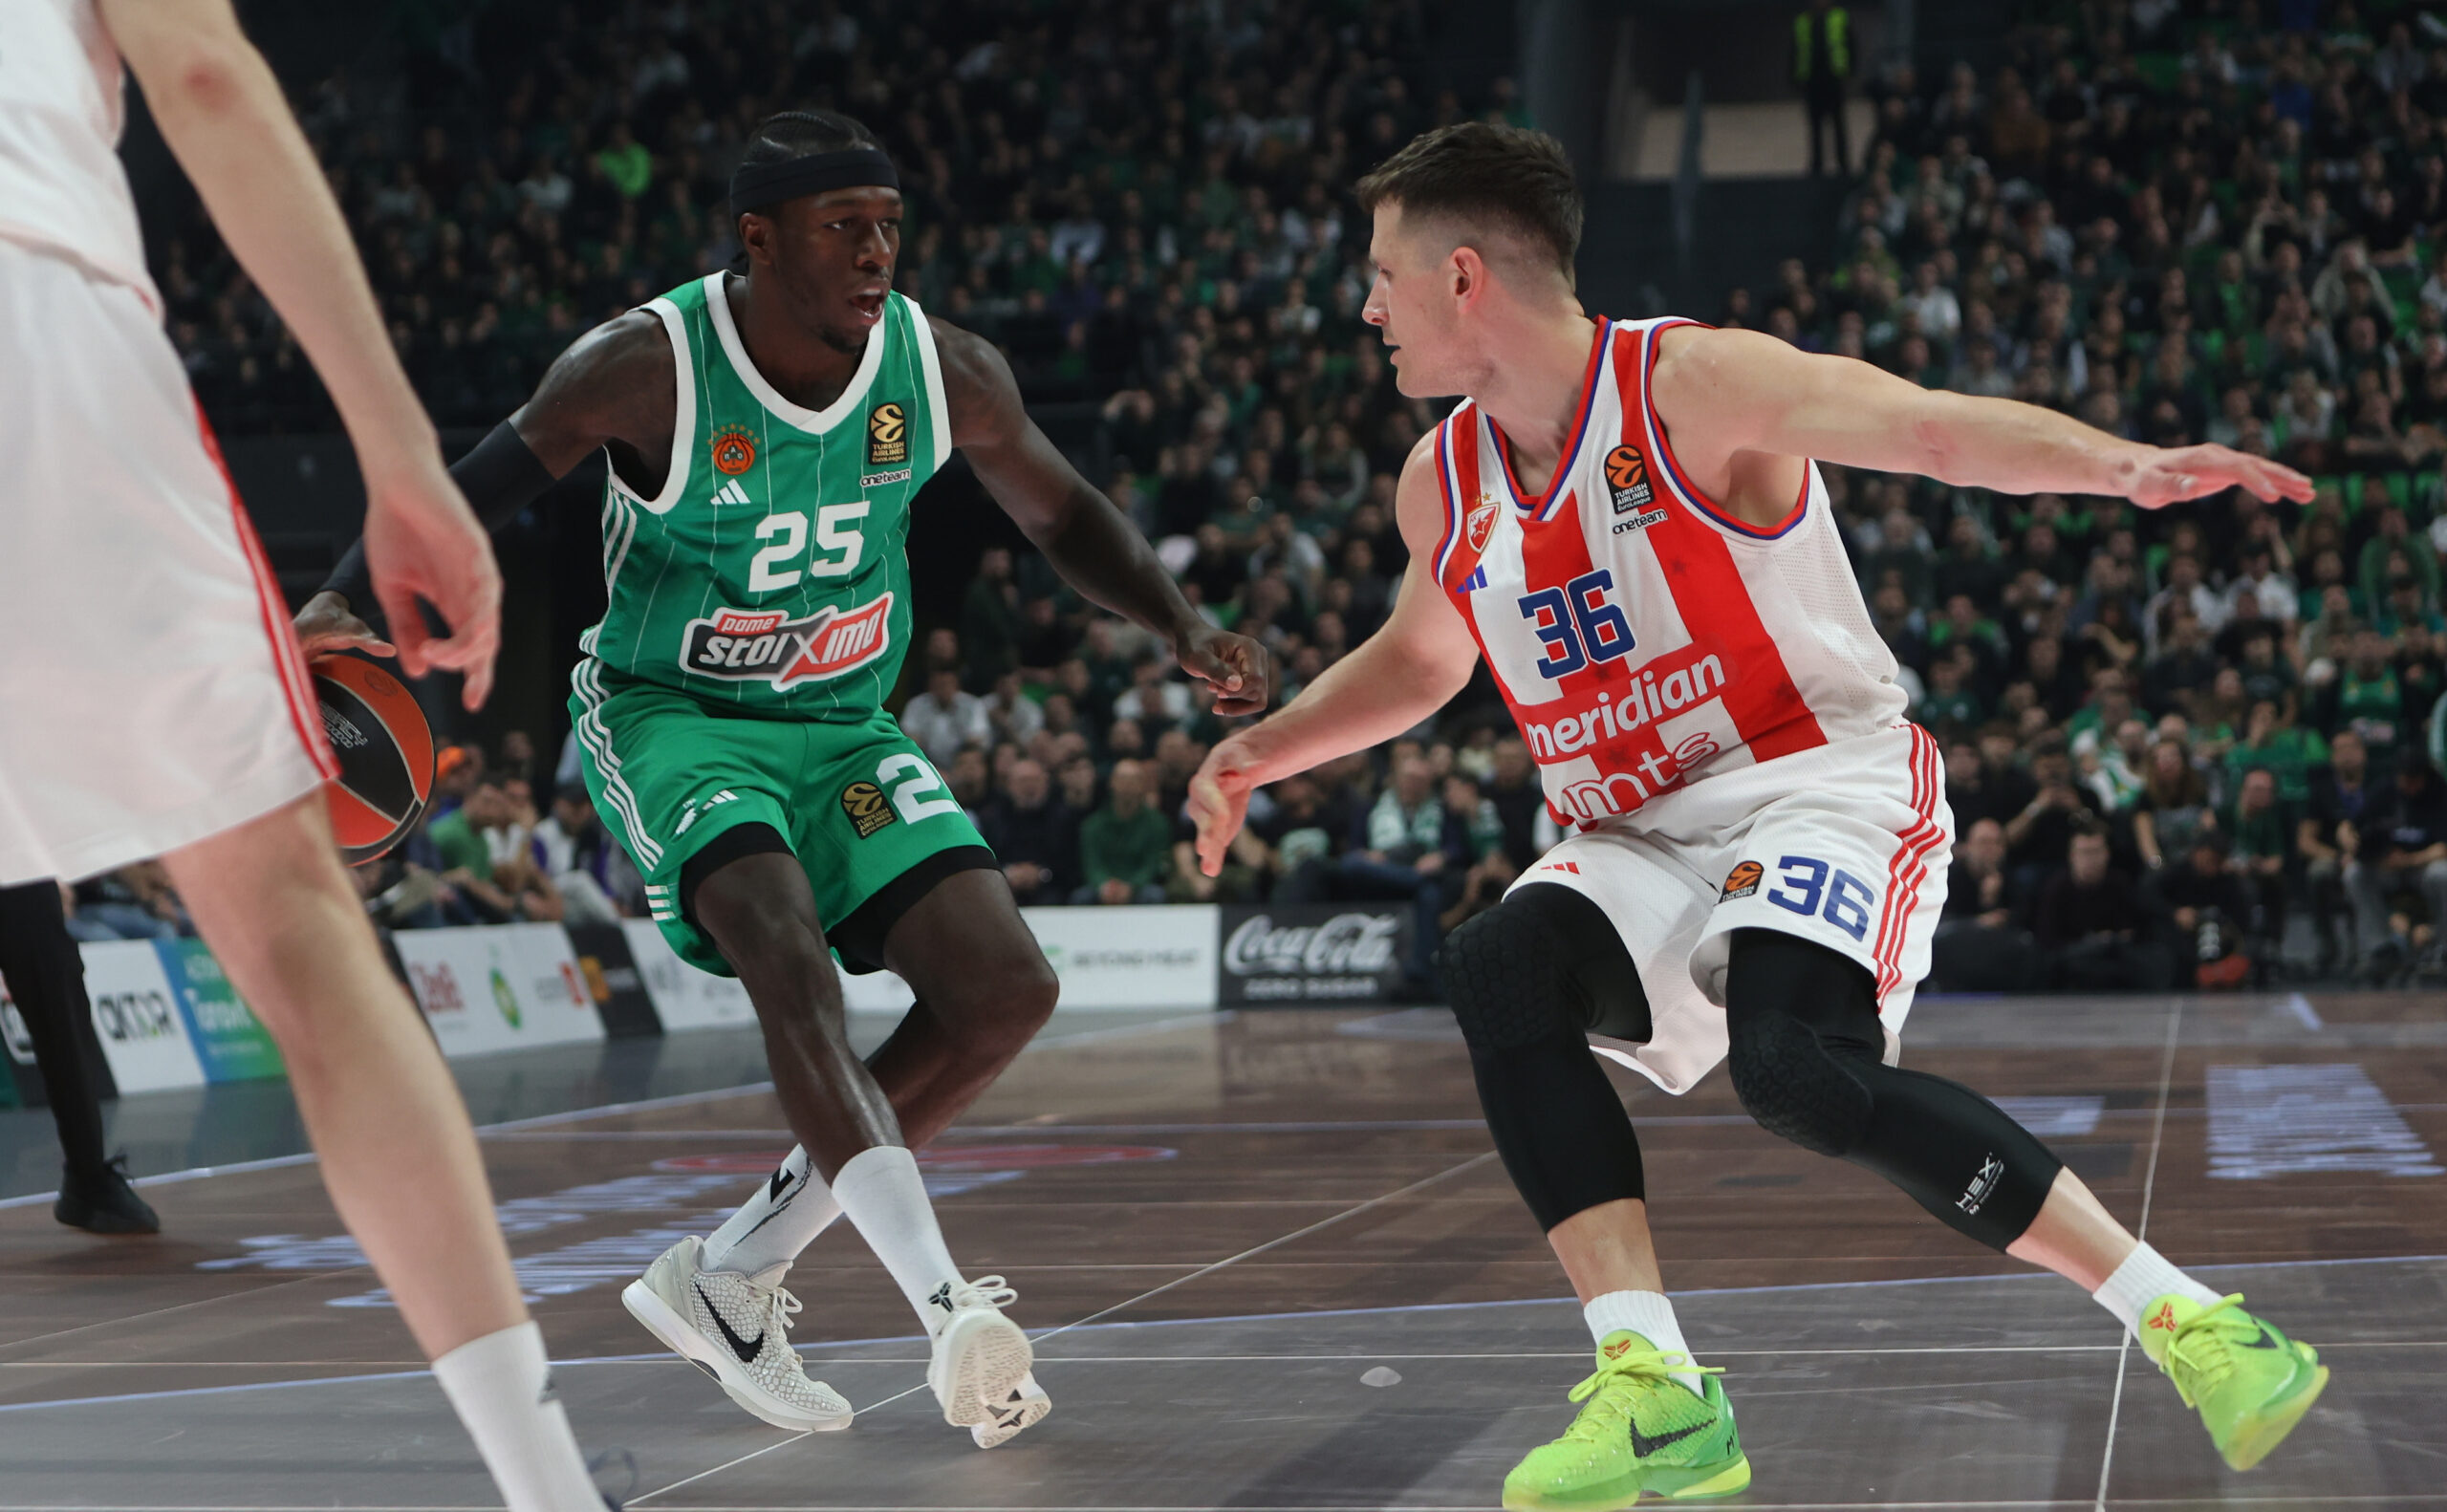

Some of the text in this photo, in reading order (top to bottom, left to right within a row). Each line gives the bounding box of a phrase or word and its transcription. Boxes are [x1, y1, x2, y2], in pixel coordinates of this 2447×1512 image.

[872, 441, 905, 451] TURKISH
[872, 447, 905, 457] AIRLINES
[1614, 482, 1648, 498] TURKISH
[1616, 488, 1650, 507] AIRLINES
[1617, 496, 1652, 512] EuroLeague
[1612, 509, 1667, 535] oneteam
[748, 501, 871, 593] 25
[721, 616, 775, 633] pame
[1517, 568, 1636, 680] 36
[1525, 654, 1726, 759] meridian
[876, 753, 960, 825] 2
[1562, 731, 1720, 820] mts
[1767, 855, 1874, 942] 36
[1955, 1155, 1996, 1210] HEX
